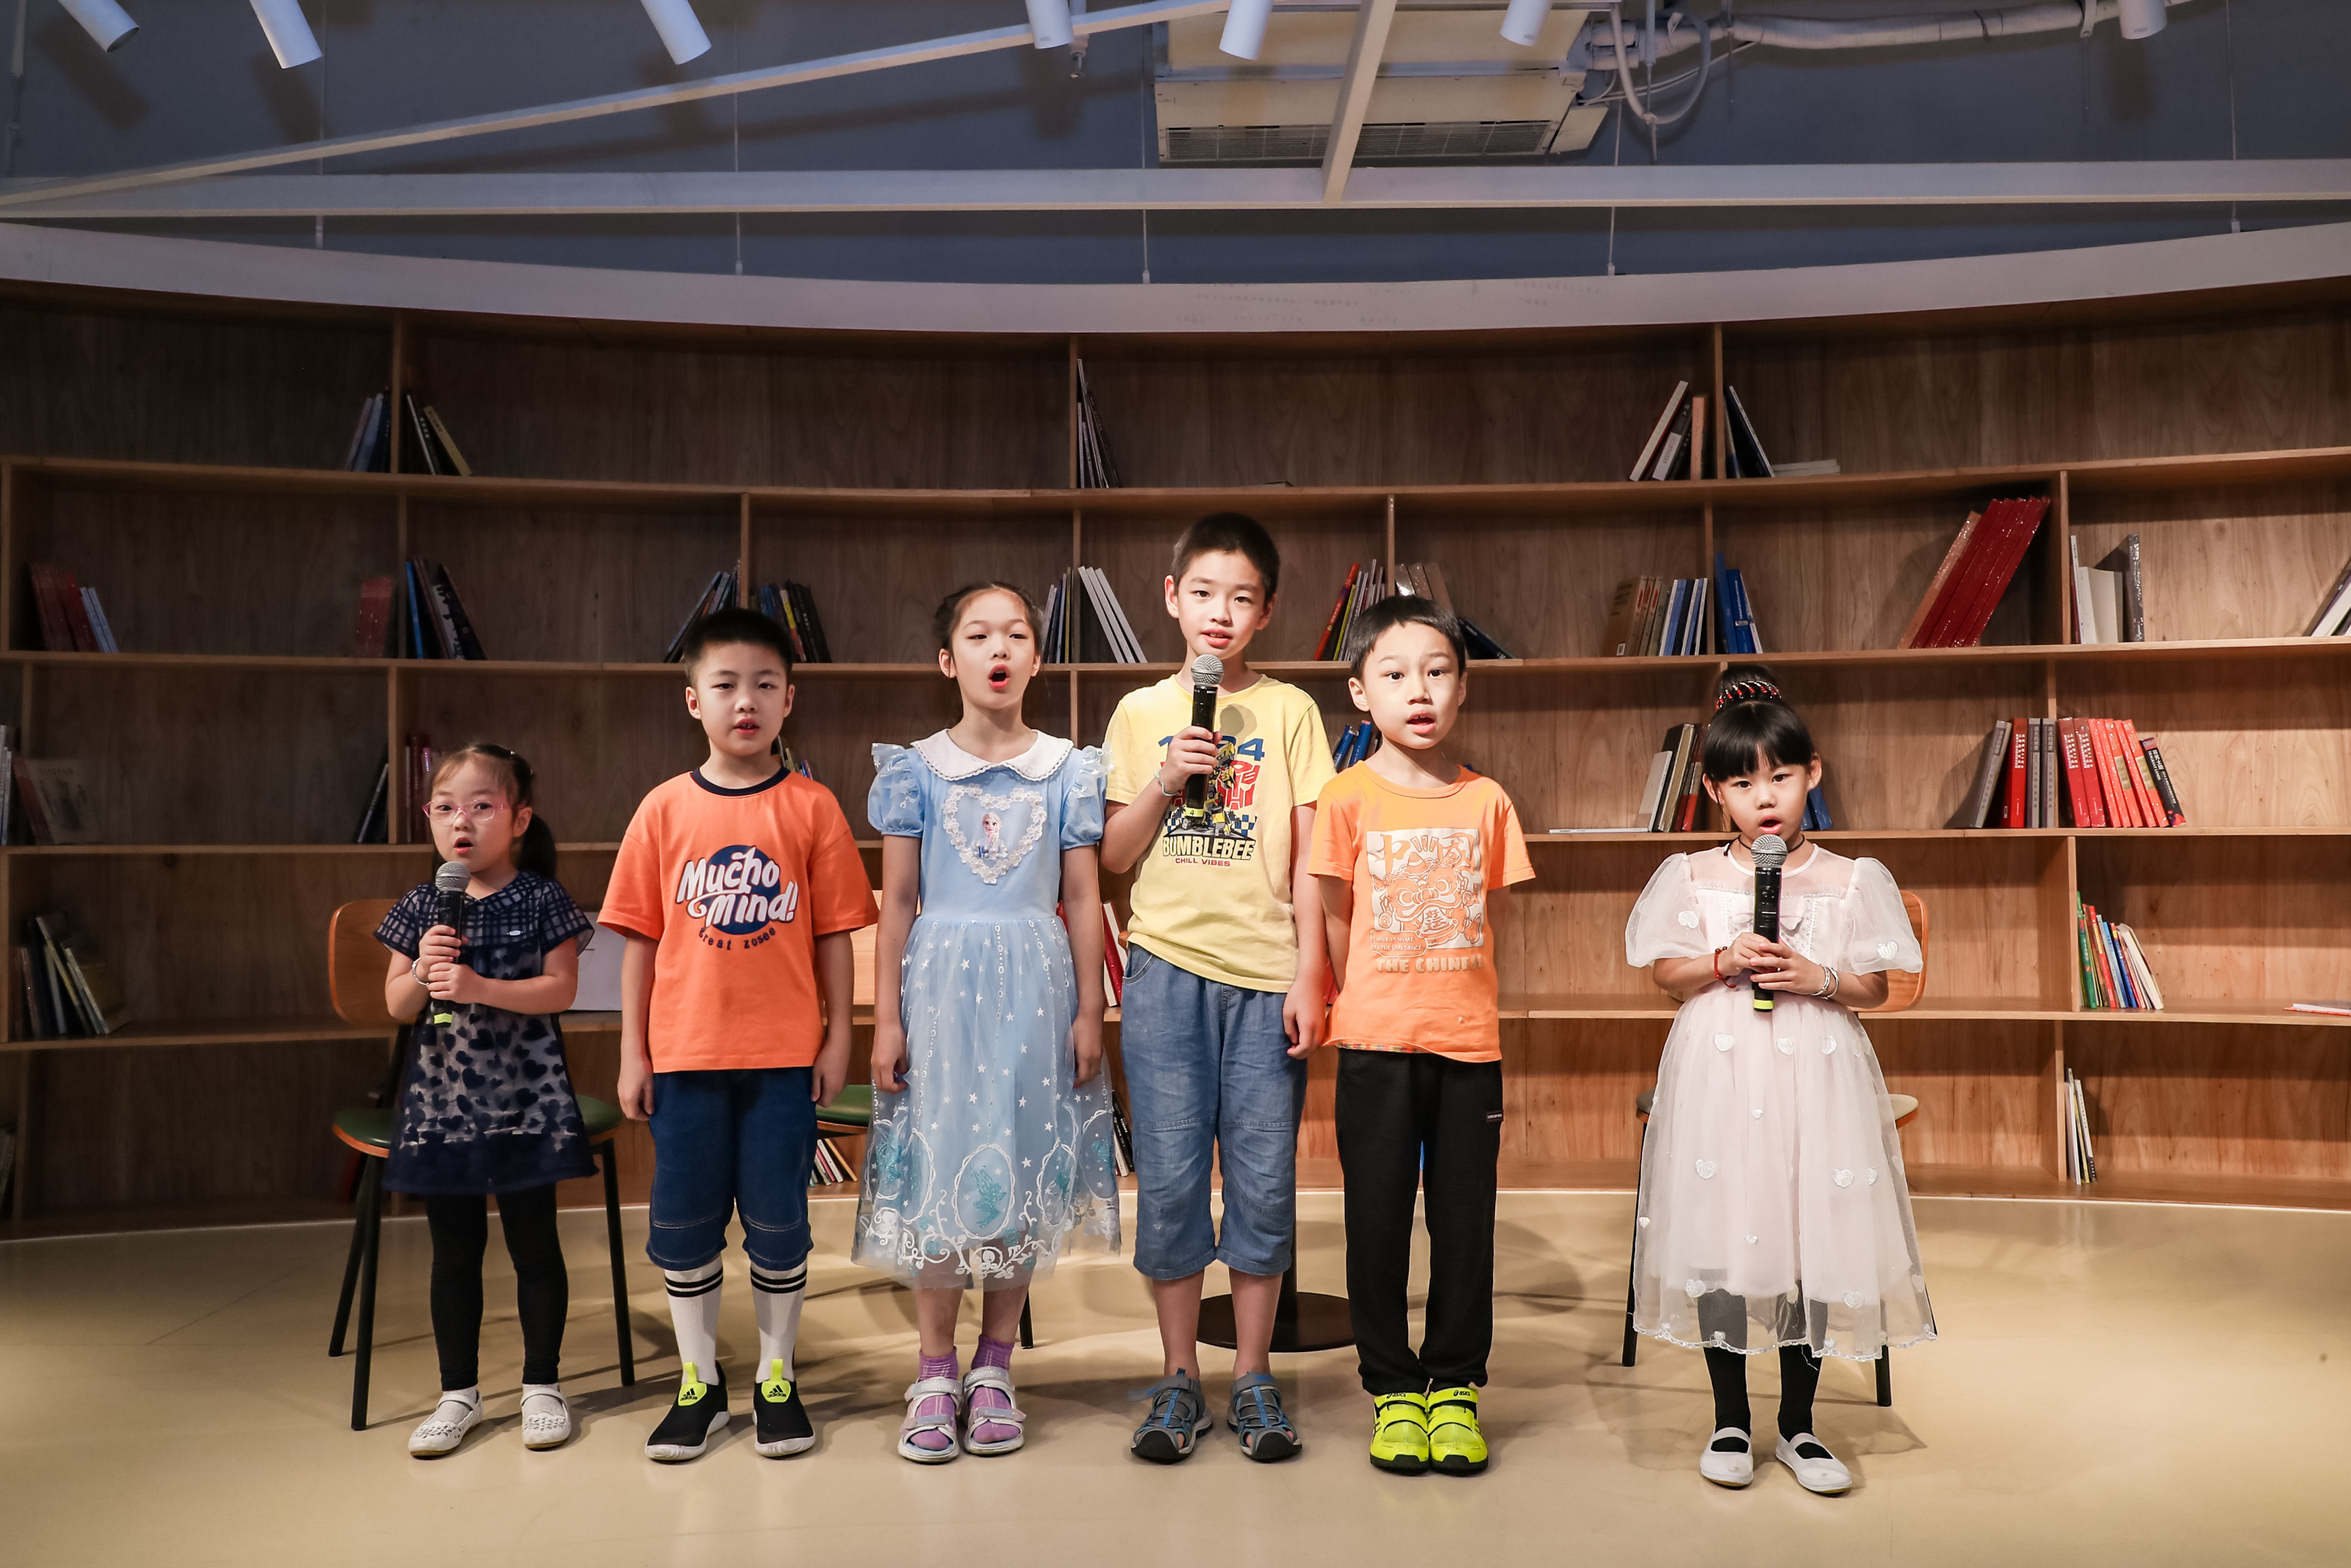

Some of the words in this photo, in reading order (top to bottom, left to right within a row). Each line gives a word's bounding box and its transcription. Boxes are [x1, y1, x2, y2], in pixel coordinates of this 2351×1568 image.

[1163, 835, 1256, 860] BUMBLEBEE
[1201, 859, 1231, 867] VIBES
[676, 846, 780, 906] Mucho
[1376, 958, 1410, 973] THE
[1415, 954, 1484, 973] CHINESE
